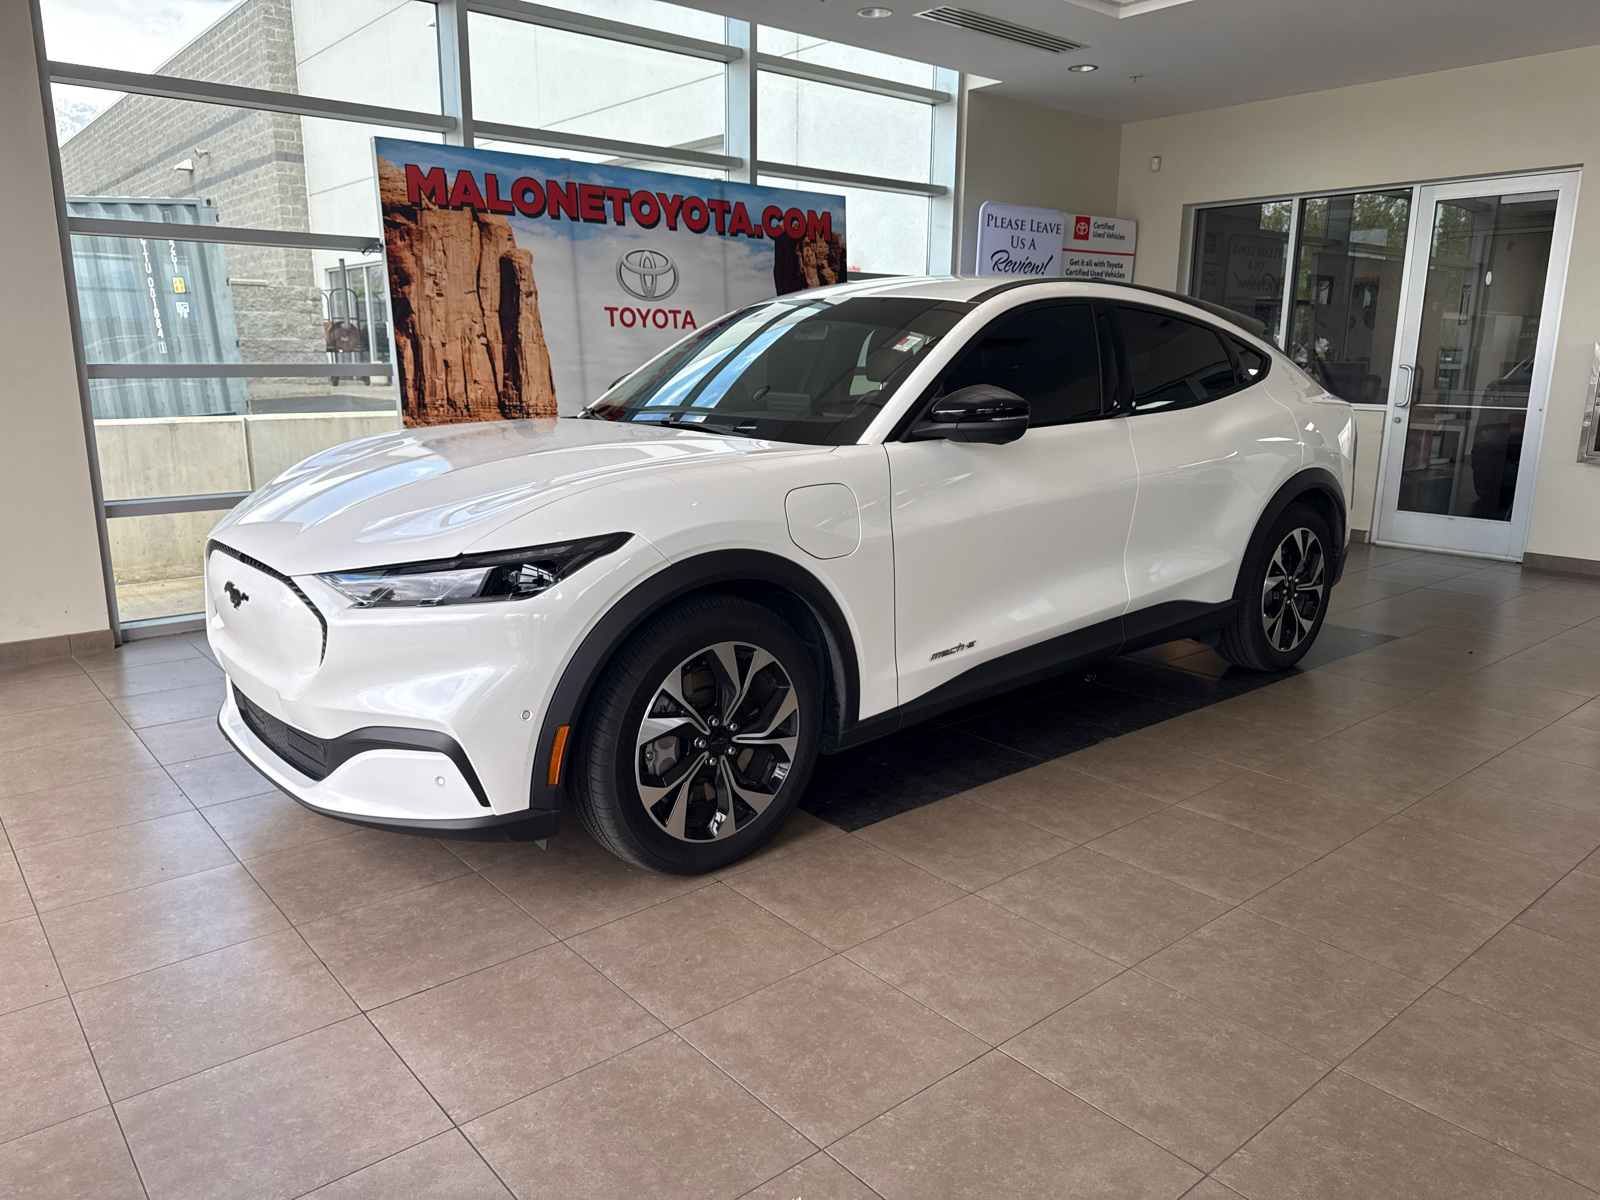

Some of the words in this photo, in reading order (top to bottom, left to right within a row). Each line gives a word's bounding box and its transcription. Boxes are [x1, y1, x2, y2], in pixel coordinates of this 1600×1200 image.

[405, 164, 832, 242] MALONETOYOTA.COM
[987, 213, 1026, 231] PLEASE
[1029, 219, 1062, 235] LEAVE
[1093, 222, 1115, 231] Certified
[1093, 231, 1105, 239] Used
[1106, 231, 1126, 241] Vehicles
[1028, 238, 1037, 250] A
[990, 249, 1054, 276] Review!
[1069, 258, 1080, 267] Get
[1080, 258, 1085, 267] it
[1093, 259, 1106, 268] with
[1106, 261, 1124, 270] Toyota
[1065, 268, 1089, 277] Certified
[1090, 269, 1104, 278] Used
[1104, 270, 1126, 279] Vehicles
[604, 306, 698, 330] TOYOTA
